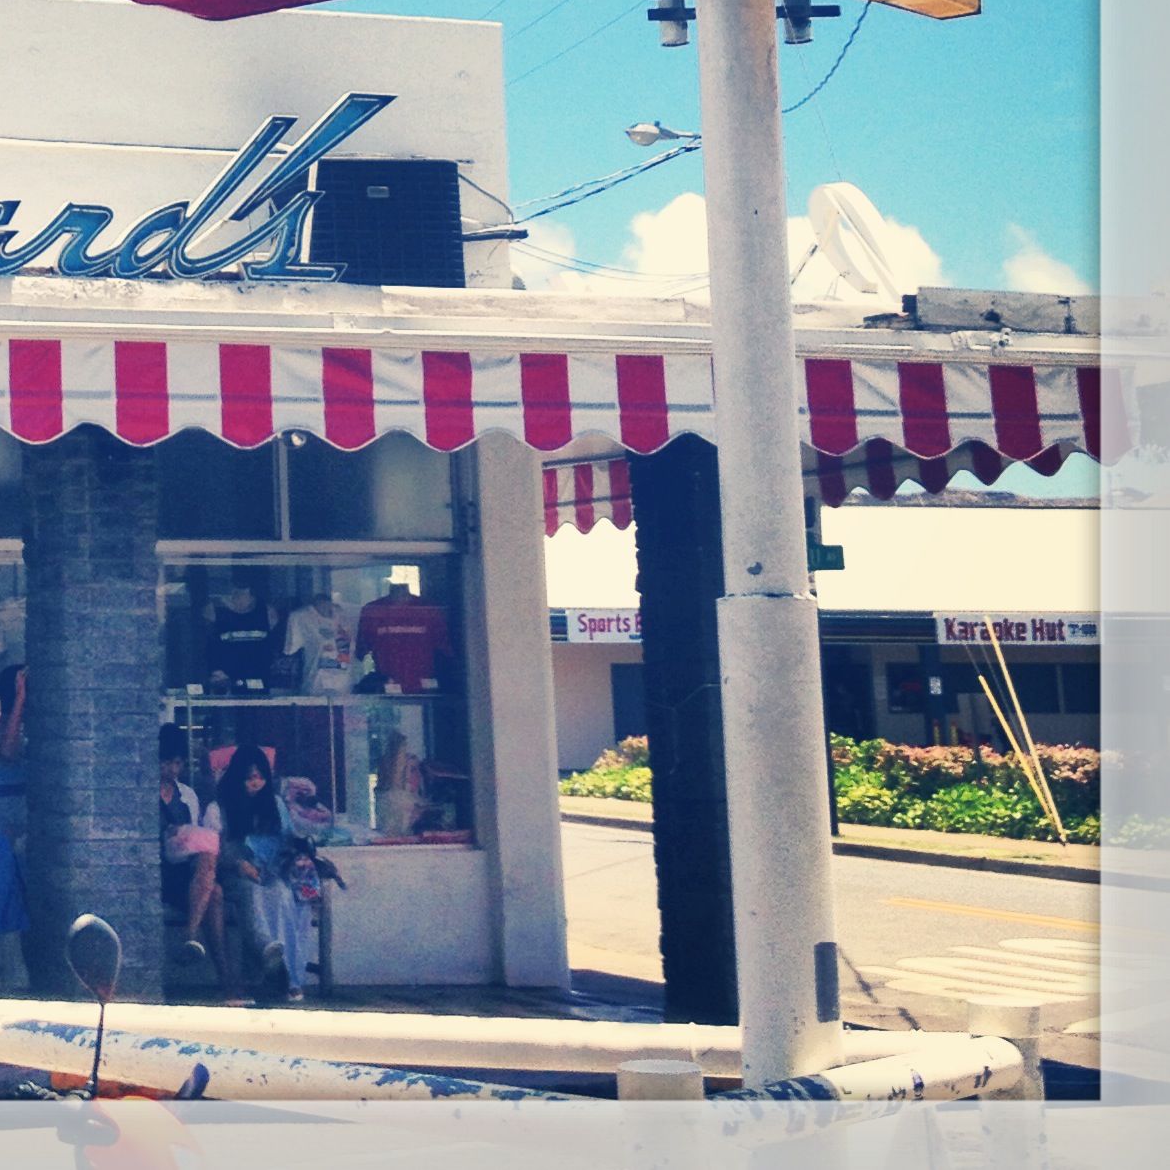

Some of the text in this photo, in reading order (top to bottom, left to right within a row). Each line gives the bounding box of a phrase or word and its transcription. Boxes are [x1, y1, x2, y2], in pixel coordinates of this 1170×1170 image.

[577, 613, 631, 641] Sports
[944, 617, 1028, 642] Karaoke
[1031, 618, 1066, 642] Hut
